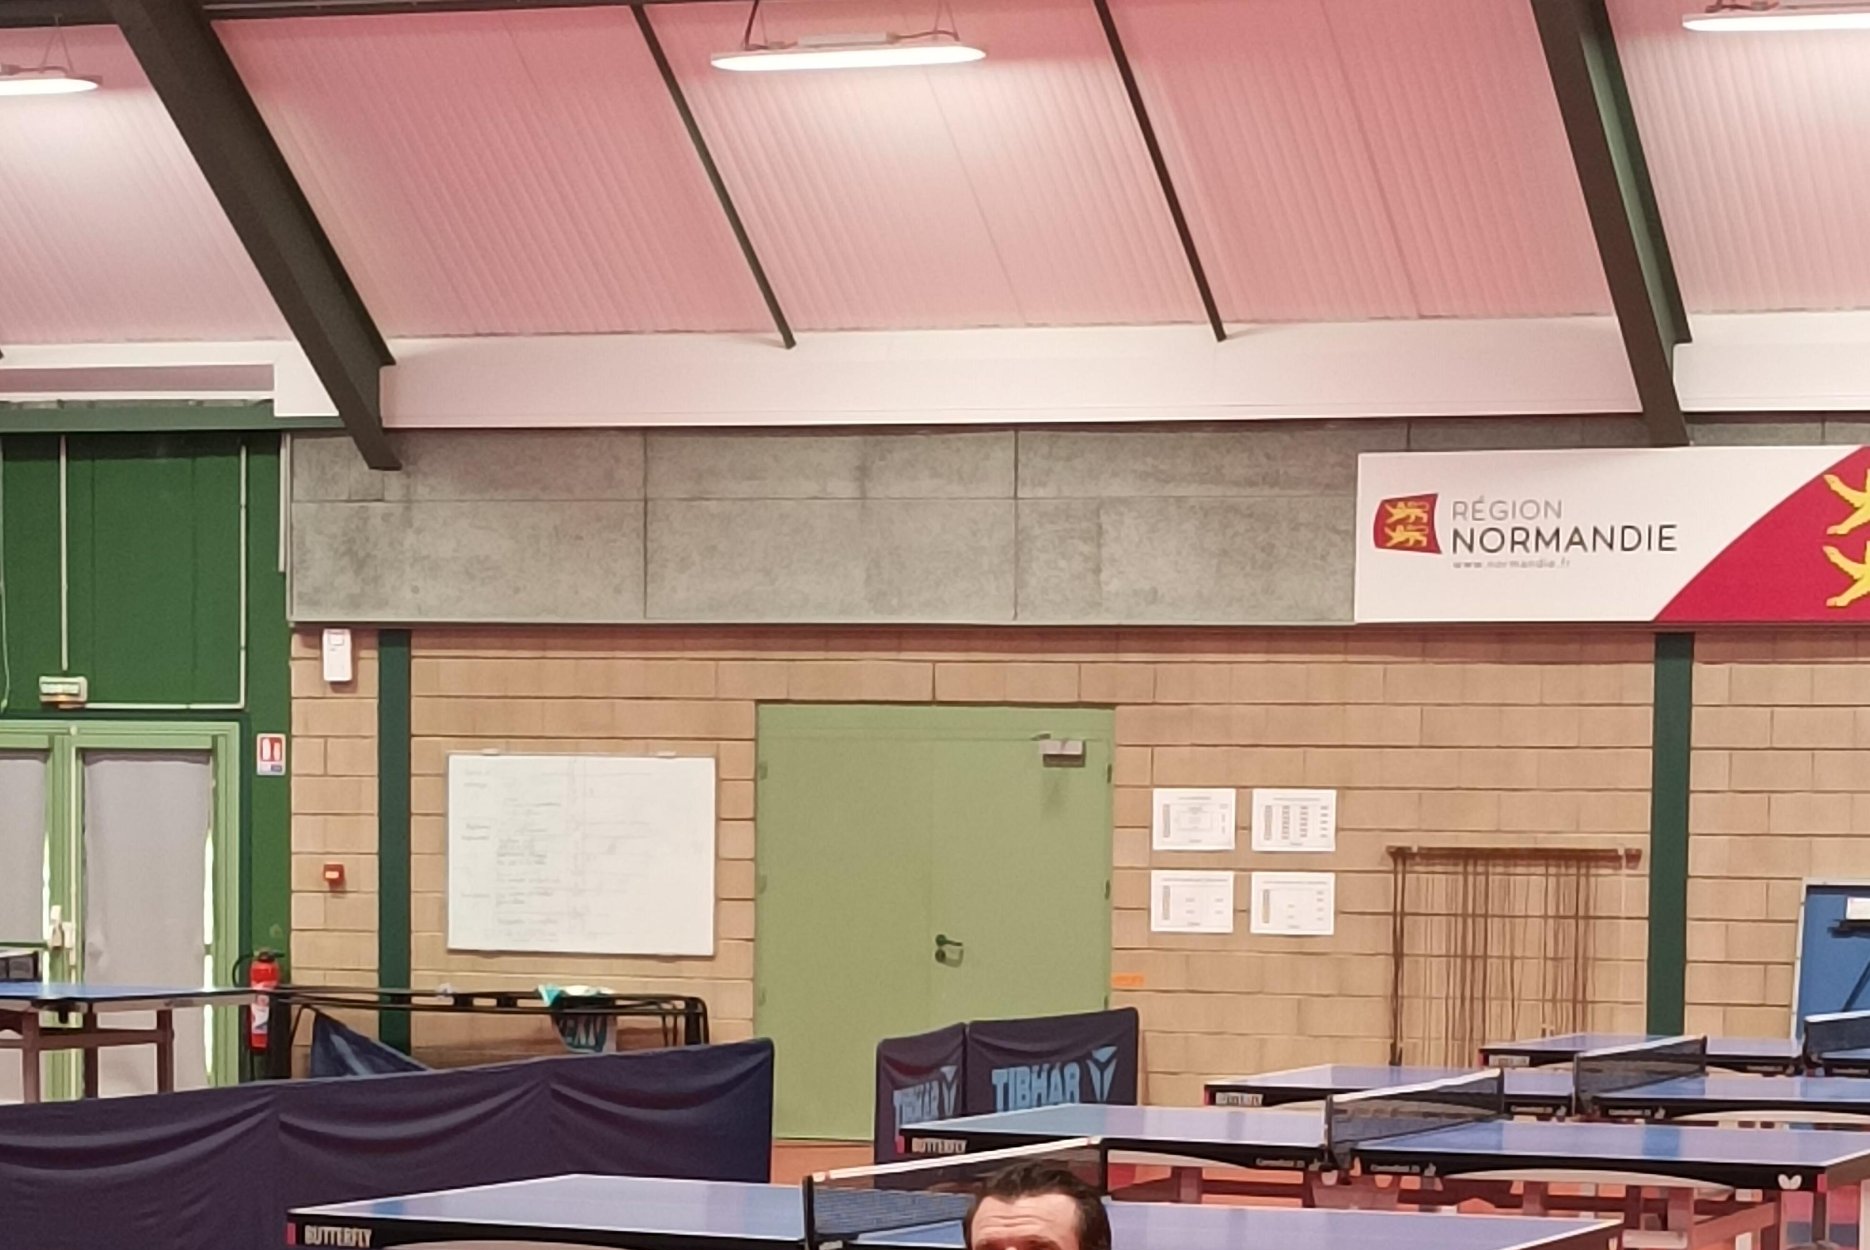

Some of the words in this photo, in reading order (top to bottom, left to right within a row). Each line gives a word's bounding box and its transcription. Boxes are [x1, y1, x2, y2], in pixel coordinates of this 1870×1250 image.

[1452, 495, 1562, 521] RÉGION
[1452, 524, 1678, 554] NORMANDIE
[993, 1062, 1080, 1112] TIBHAR
[304, 1225, 372, 1248] BUTTERFLY
